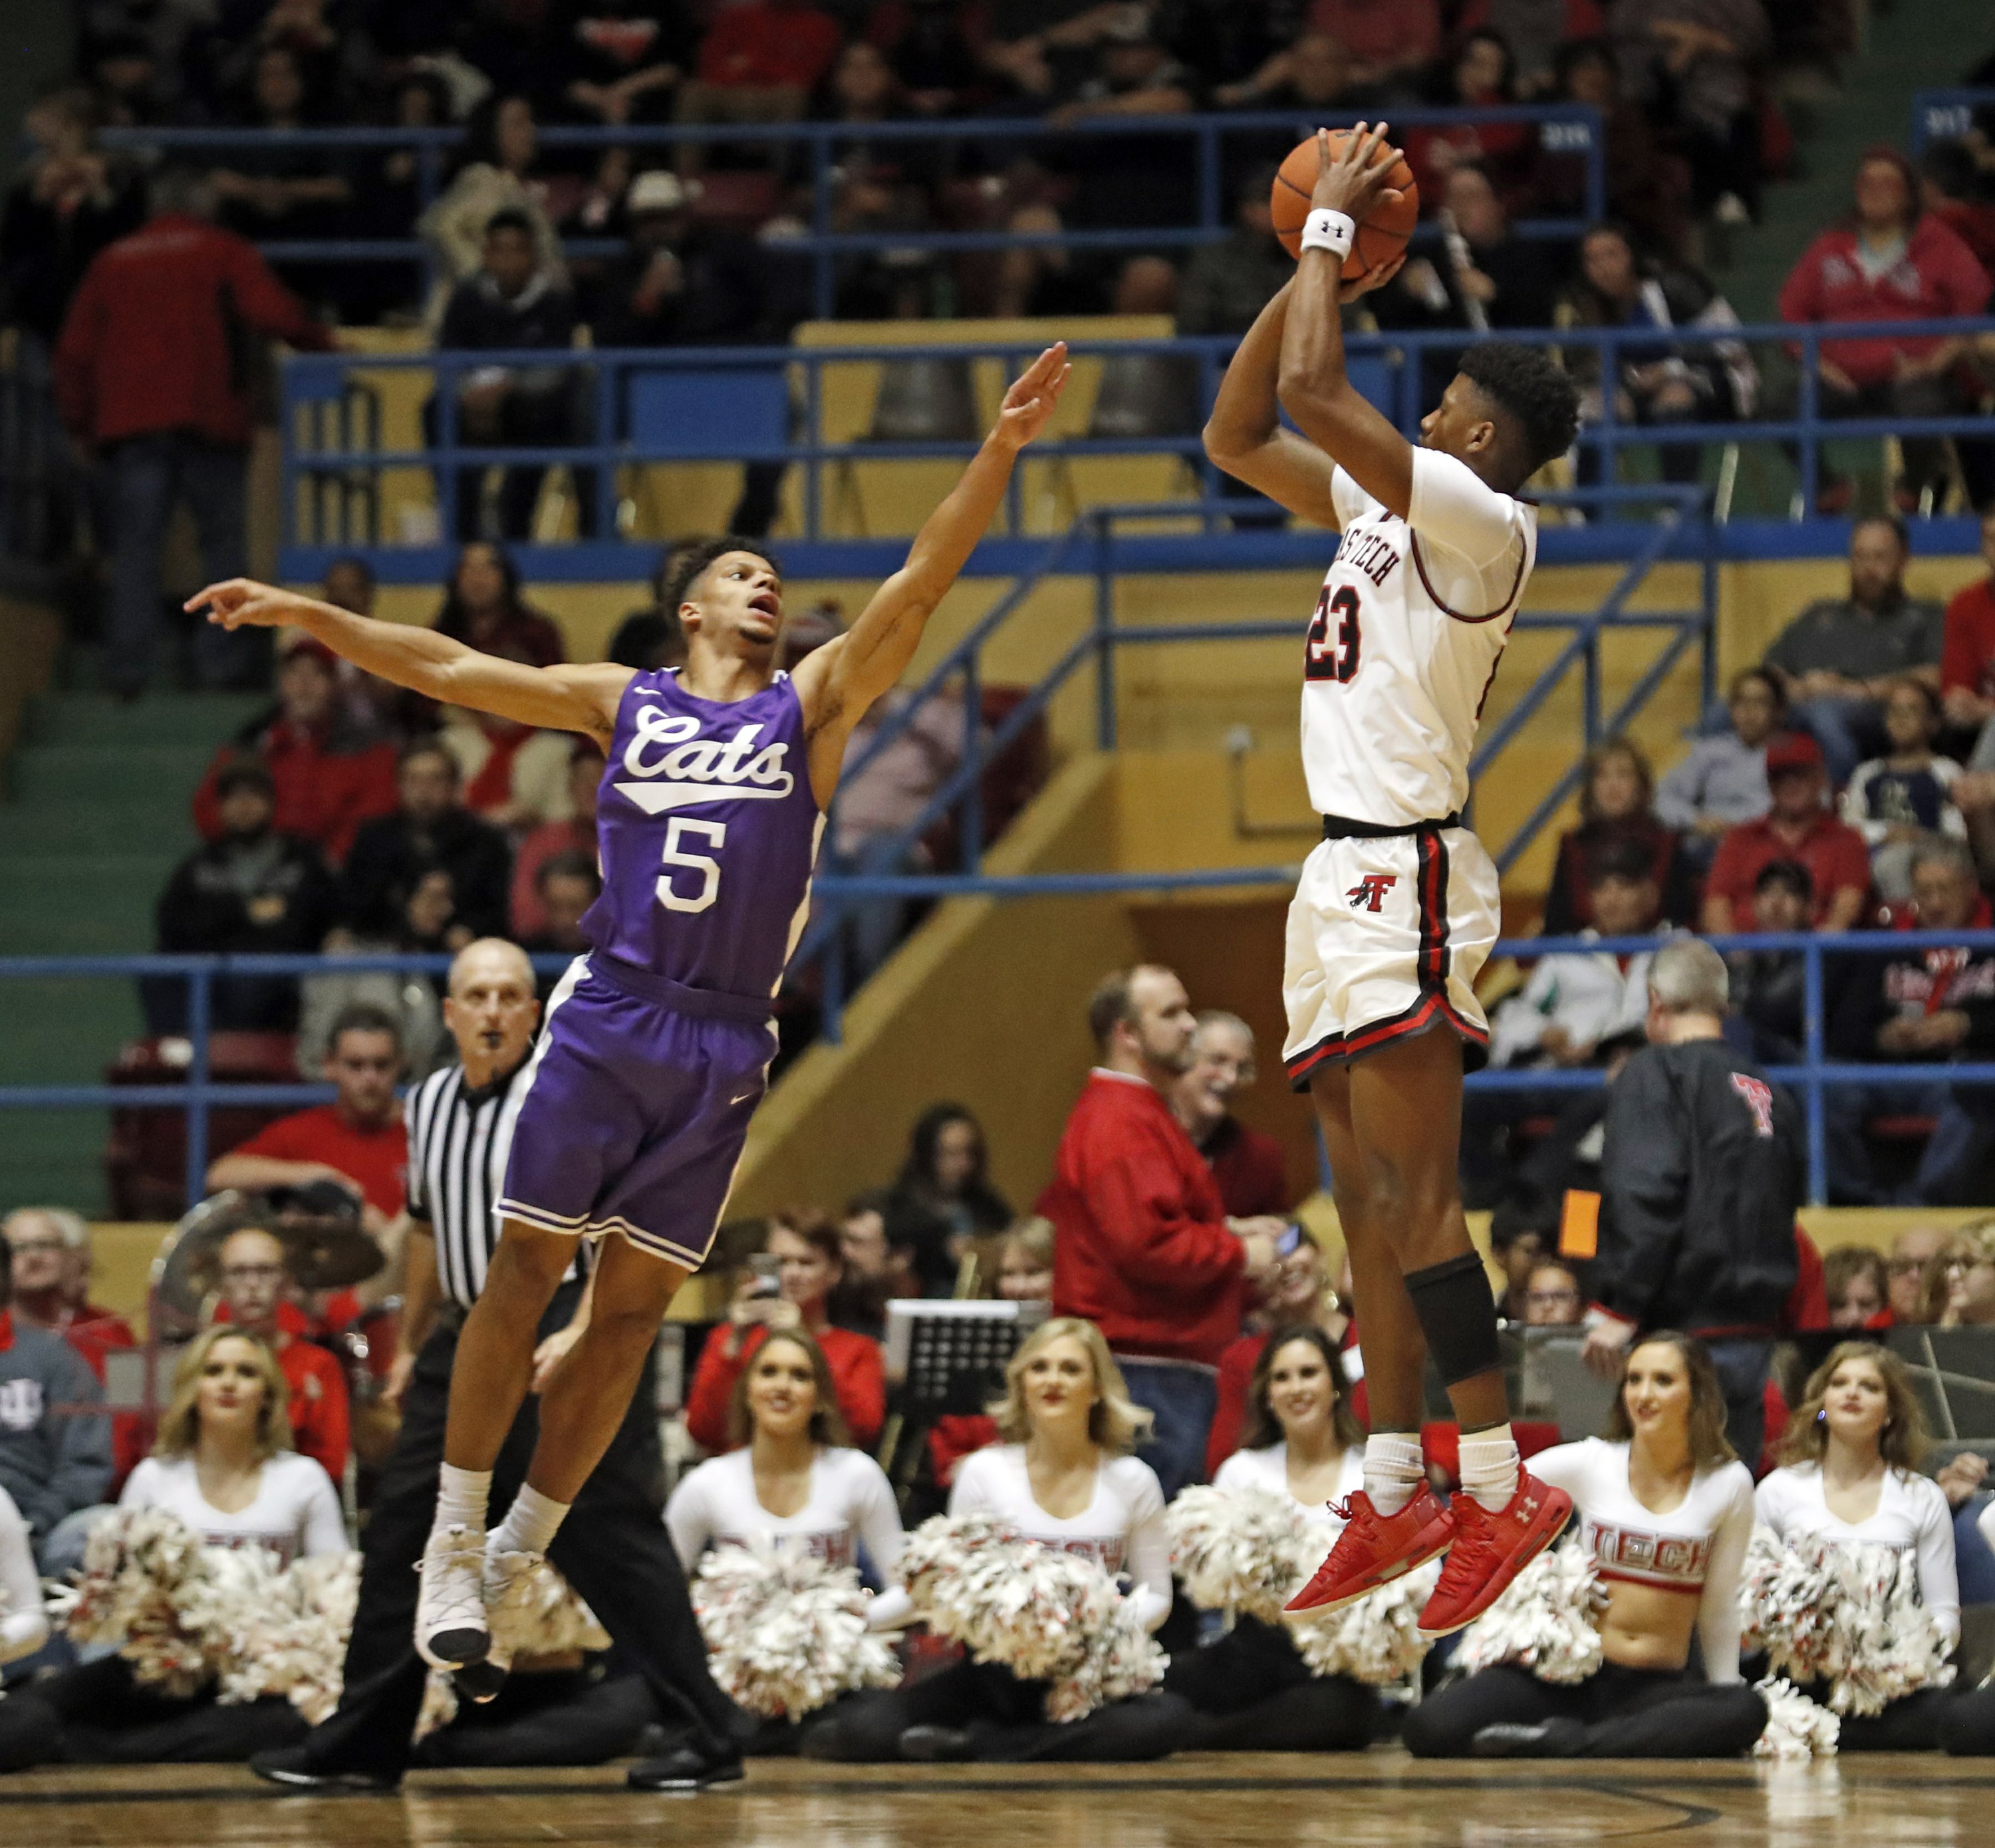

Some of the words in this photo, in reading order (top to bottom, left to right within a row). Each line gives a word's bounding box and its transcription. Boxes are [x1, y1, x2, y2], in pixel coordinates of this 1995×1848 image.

[1349, 534, 1400, 587] TECH
[1305, 584, 1362, 684] 23
[622, 704, 794, 799] Cats
[655, 816, 726, 914] 5
[1587, 1519, 1713, 1575] TECH
